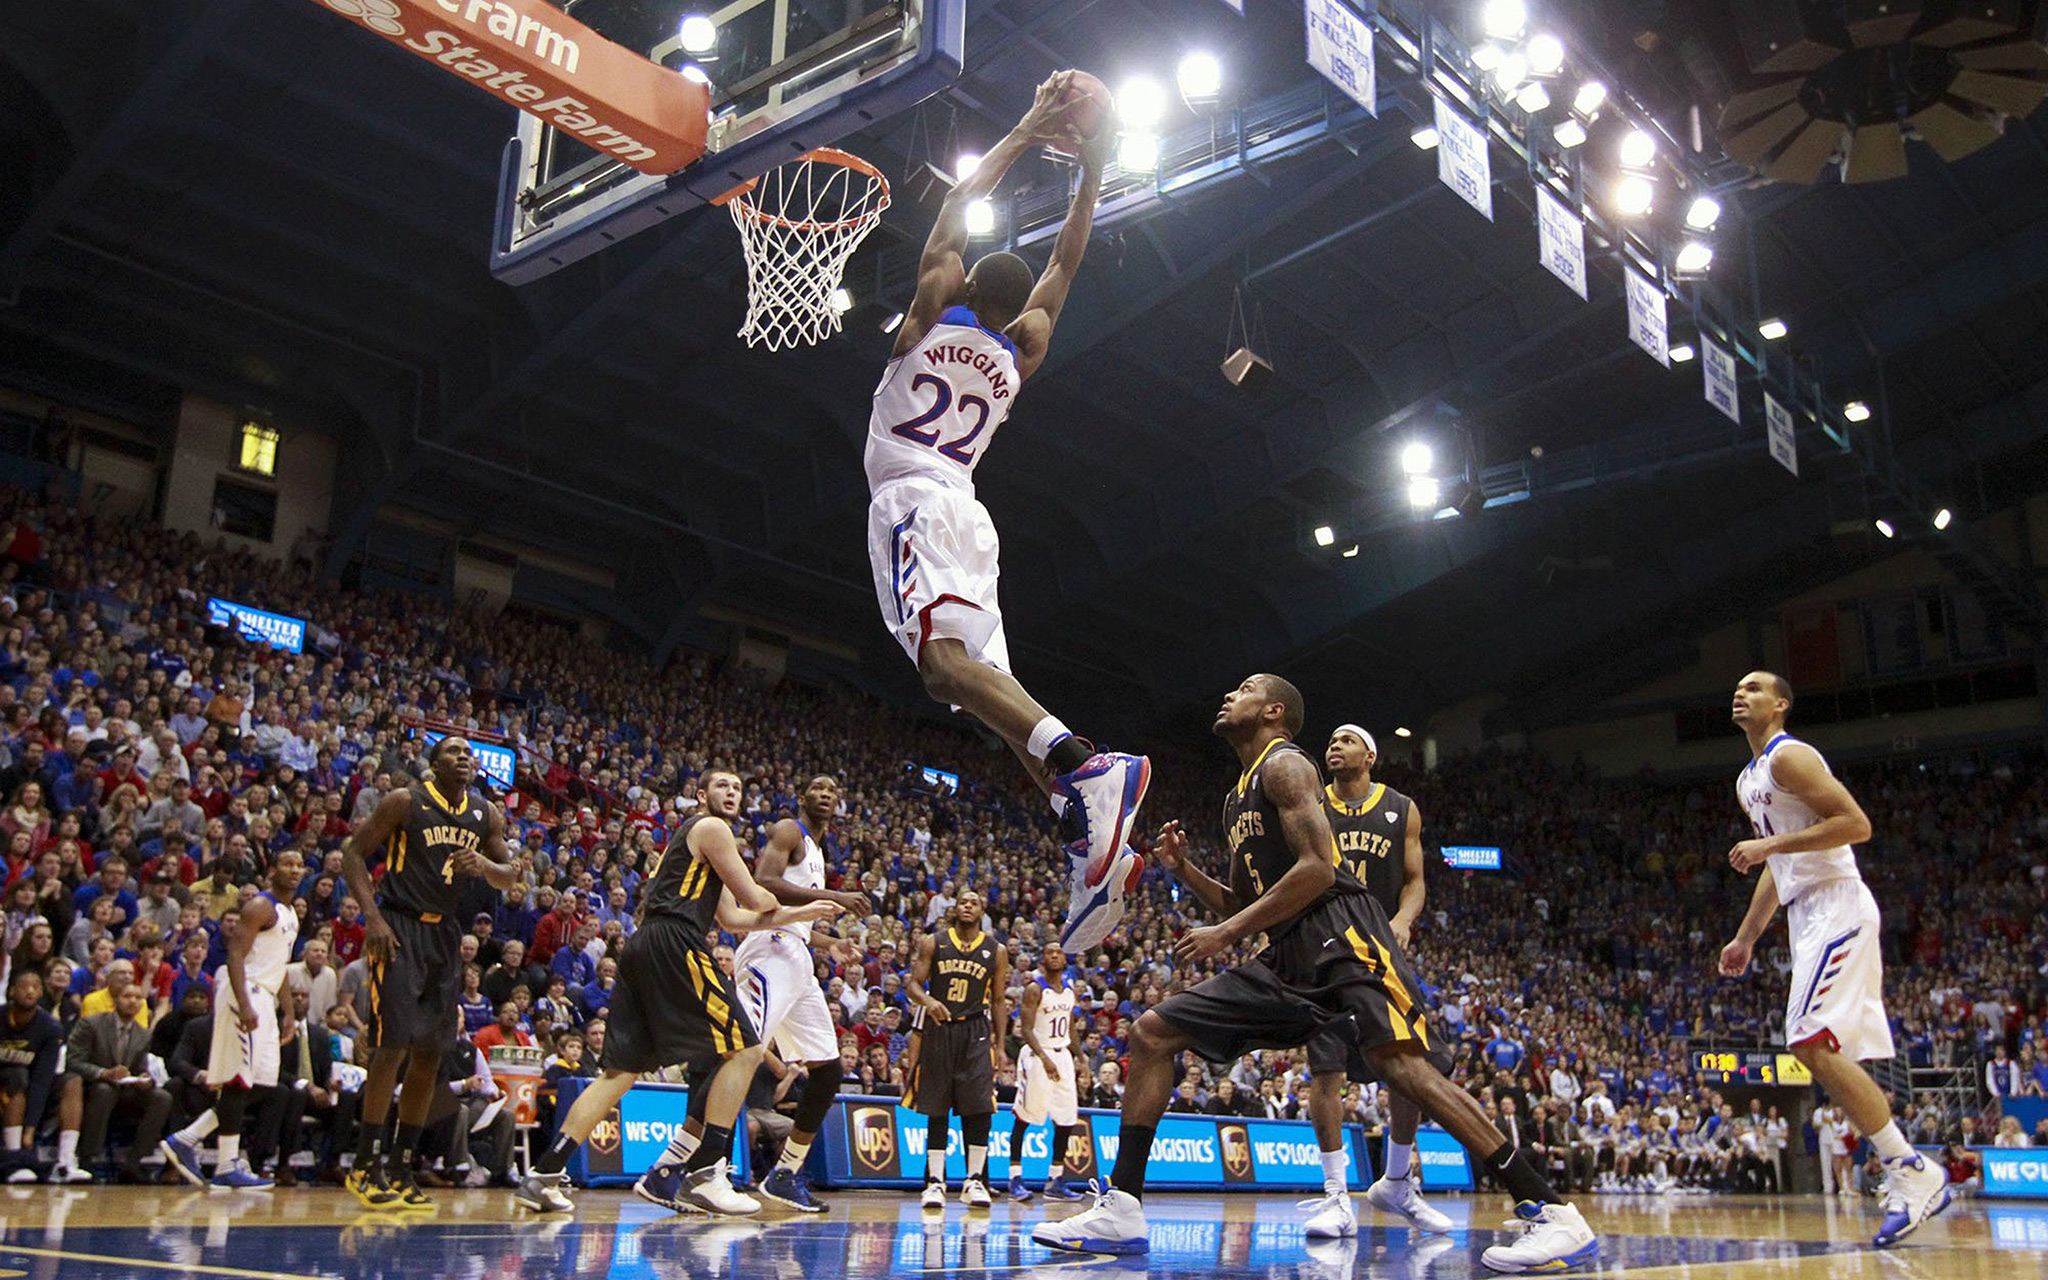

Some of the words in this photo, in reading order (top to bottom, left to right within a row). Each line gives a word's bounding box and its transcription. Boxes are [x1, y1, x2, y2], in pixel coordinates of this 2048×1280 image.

[405, 30, 545, 103] State
[537, 95, 657, 162] Farm
[923, 345, 1009, 400] WIGGINS
[891, 373, 990, 466] 22
[237, 610, 301, 638] SHELTER
[423, 825, 481, 851] ROCKETS
[1339, 831, 1392, 859] CKETS
[441, 853, 454, 885] 4
[1244, 853, 1264, 895] 5
[938, 958, 987, 980] ROCKETS
[947, 978, 969, 1003] 20
[1049, 1016, 1068, 1039] 10
[517, 1083, 534, 1101] G
[625, 1121, 650, 1142] WE
[858, 1127, 891, 1162] ups
[904, 1127, 928, 1156] W
[1228, 1140, 1248, 1169] ups
[1254, 1142, 1279, 1165] WE
[1990, 1161, 2019, 1181] WE
